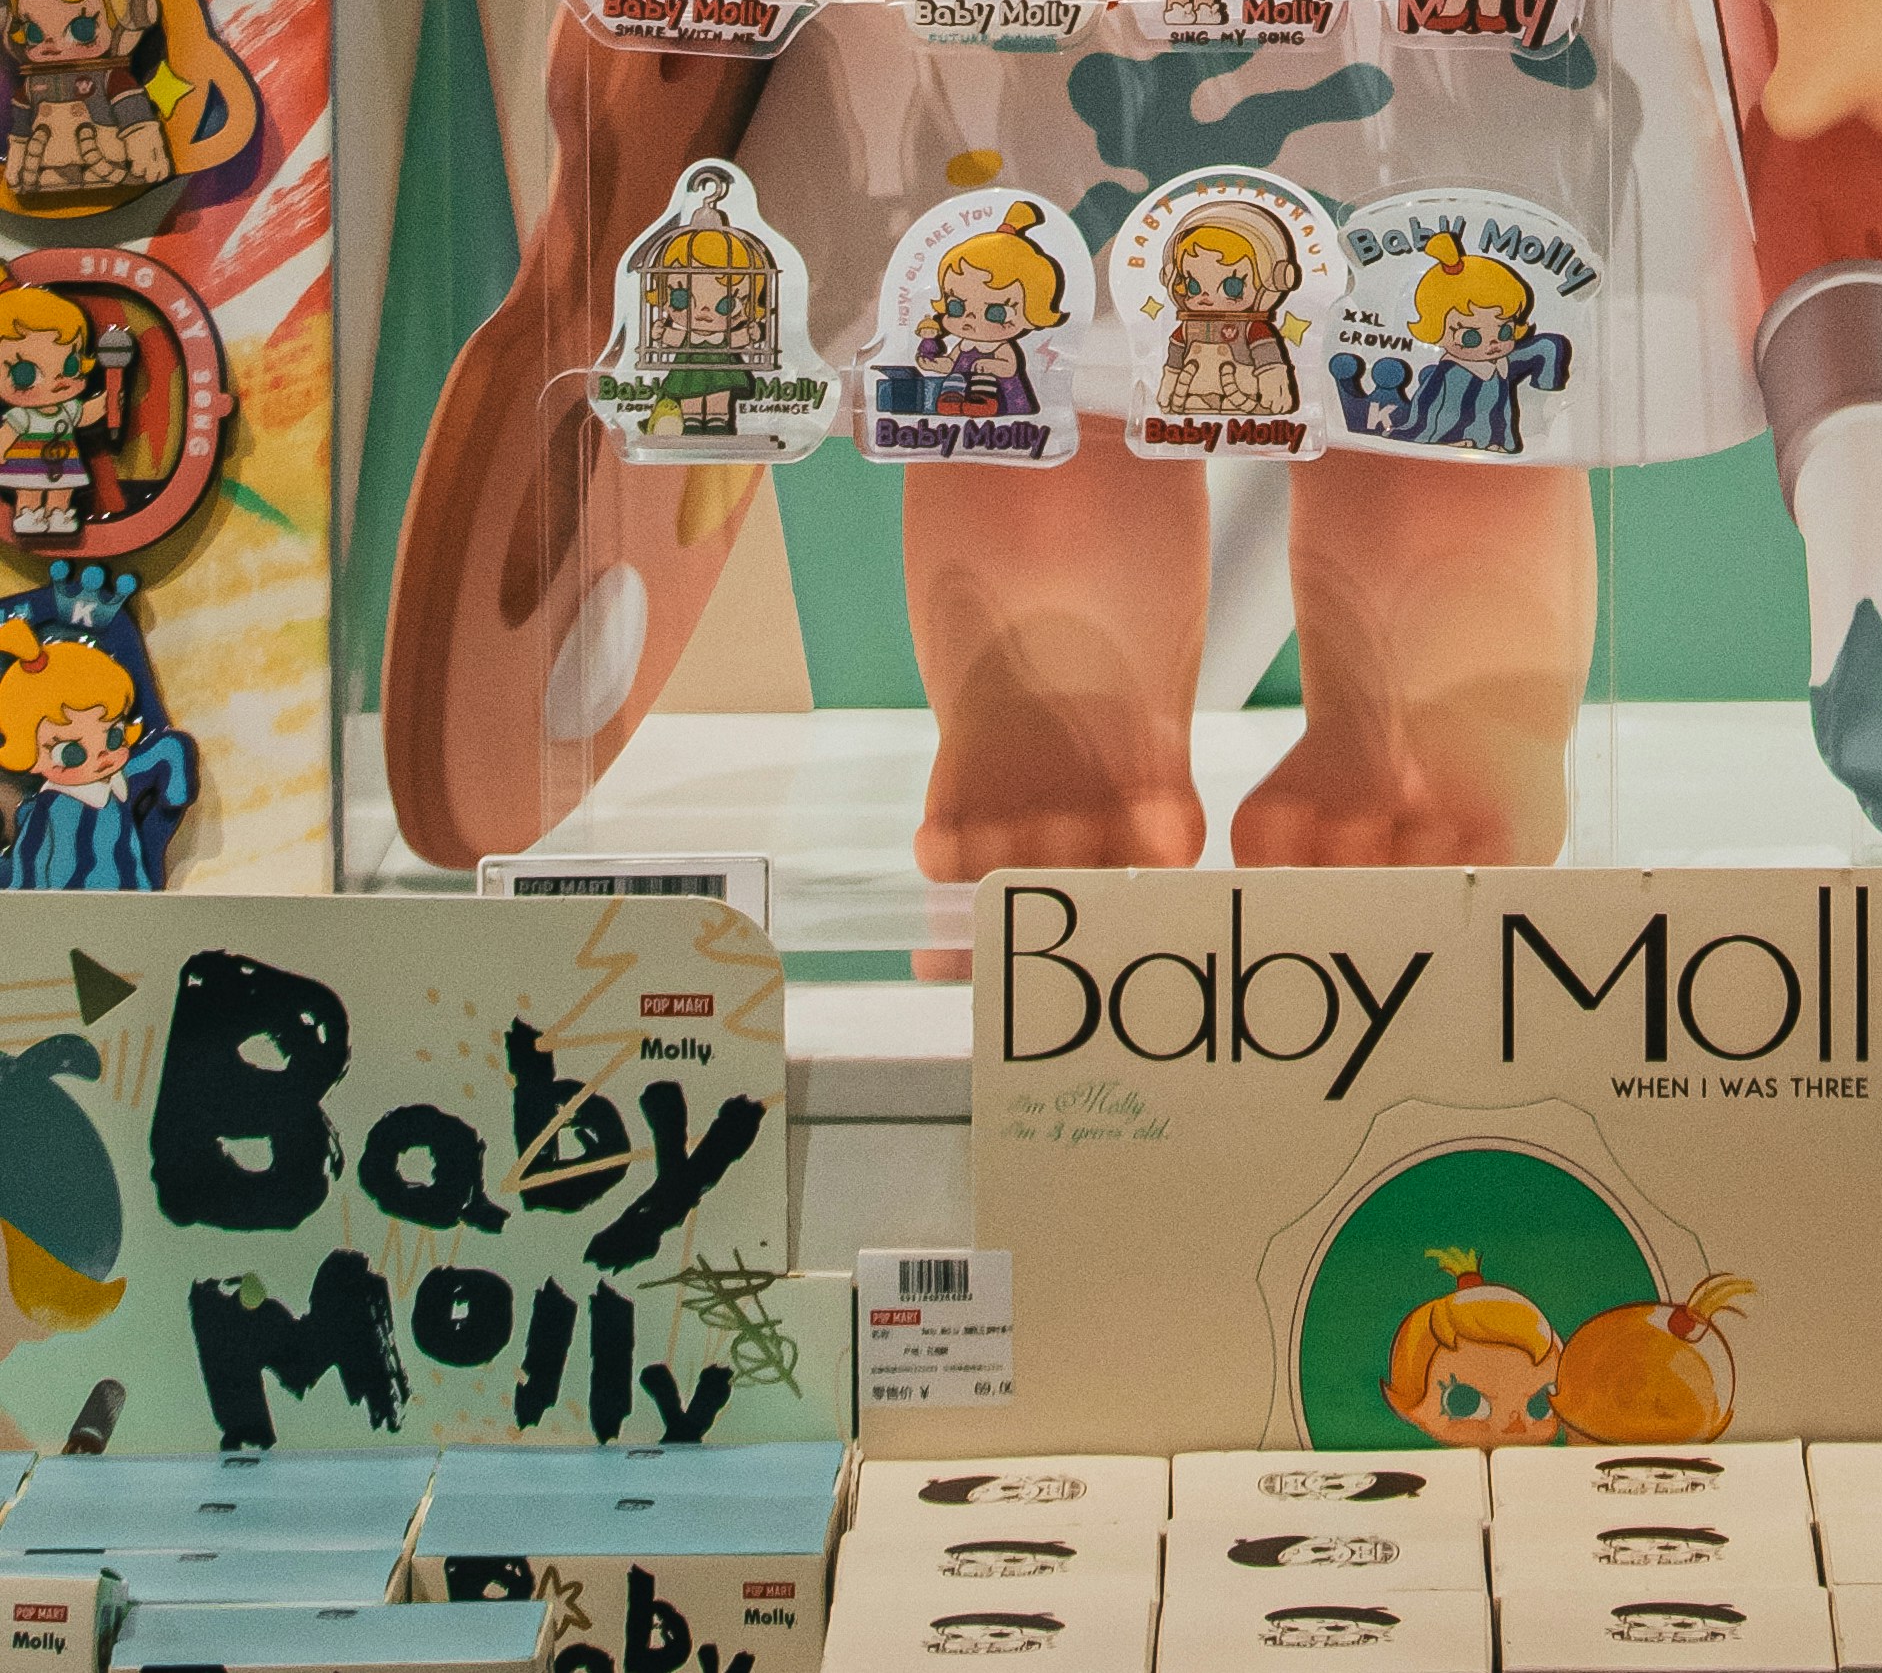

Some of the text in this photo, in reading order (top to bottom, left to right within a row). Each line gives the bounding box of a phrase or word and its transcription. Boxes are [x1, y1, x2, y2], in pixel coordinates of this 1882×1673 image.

[999, 0, 1081, 35] Molly
[615, 23, 756, 44] SHARE WITH ME
[1169, 28, 1306, 46] SING MY SONG
[924, 222, 955, 248] ARE
[958, 205, 994, 228] YOU
[1126, 178, 1329, 277] BABY ASTRONAUT
[1478, 218, 1597, 297] Molly
[79, 255, 155, 288] SING
[169, 298, 208, 340] MY
[1342, 308, 1386, 328] XXL
[1339, 330, 1414, 352] CROWN
[599, 375, 828, 409] Baby Molly
[739, 402, 811, 415] EXCHANGE
[1366, 402, 1398, 430] K
[876, 418, 1051, 460] Baby Molly
[1145, 417, 1308, 454] Baby Molly
[71, 602, 98, 628] K
[559, 878, 611, 893] MART
[643, 996, 712, 1013] POP MART
[1003, 887, 1434, 1100] Baby
[640, 1037, 712, 1065] Molly
[1610, 1077, 1869, 1099] WHEN I WAS THREE
[149, 948, 768, 1277] Baby
[872, 1311, 919, 1324] POP MART
[188, 1246, 733, 1452] Molly
[745, 1583, 794, 1598] POP MART
[15, 1605, 67, 1623] POP MART
[743, 1608, 795, 1629] Molly
[12, 1631, 67, 1655] Molly
